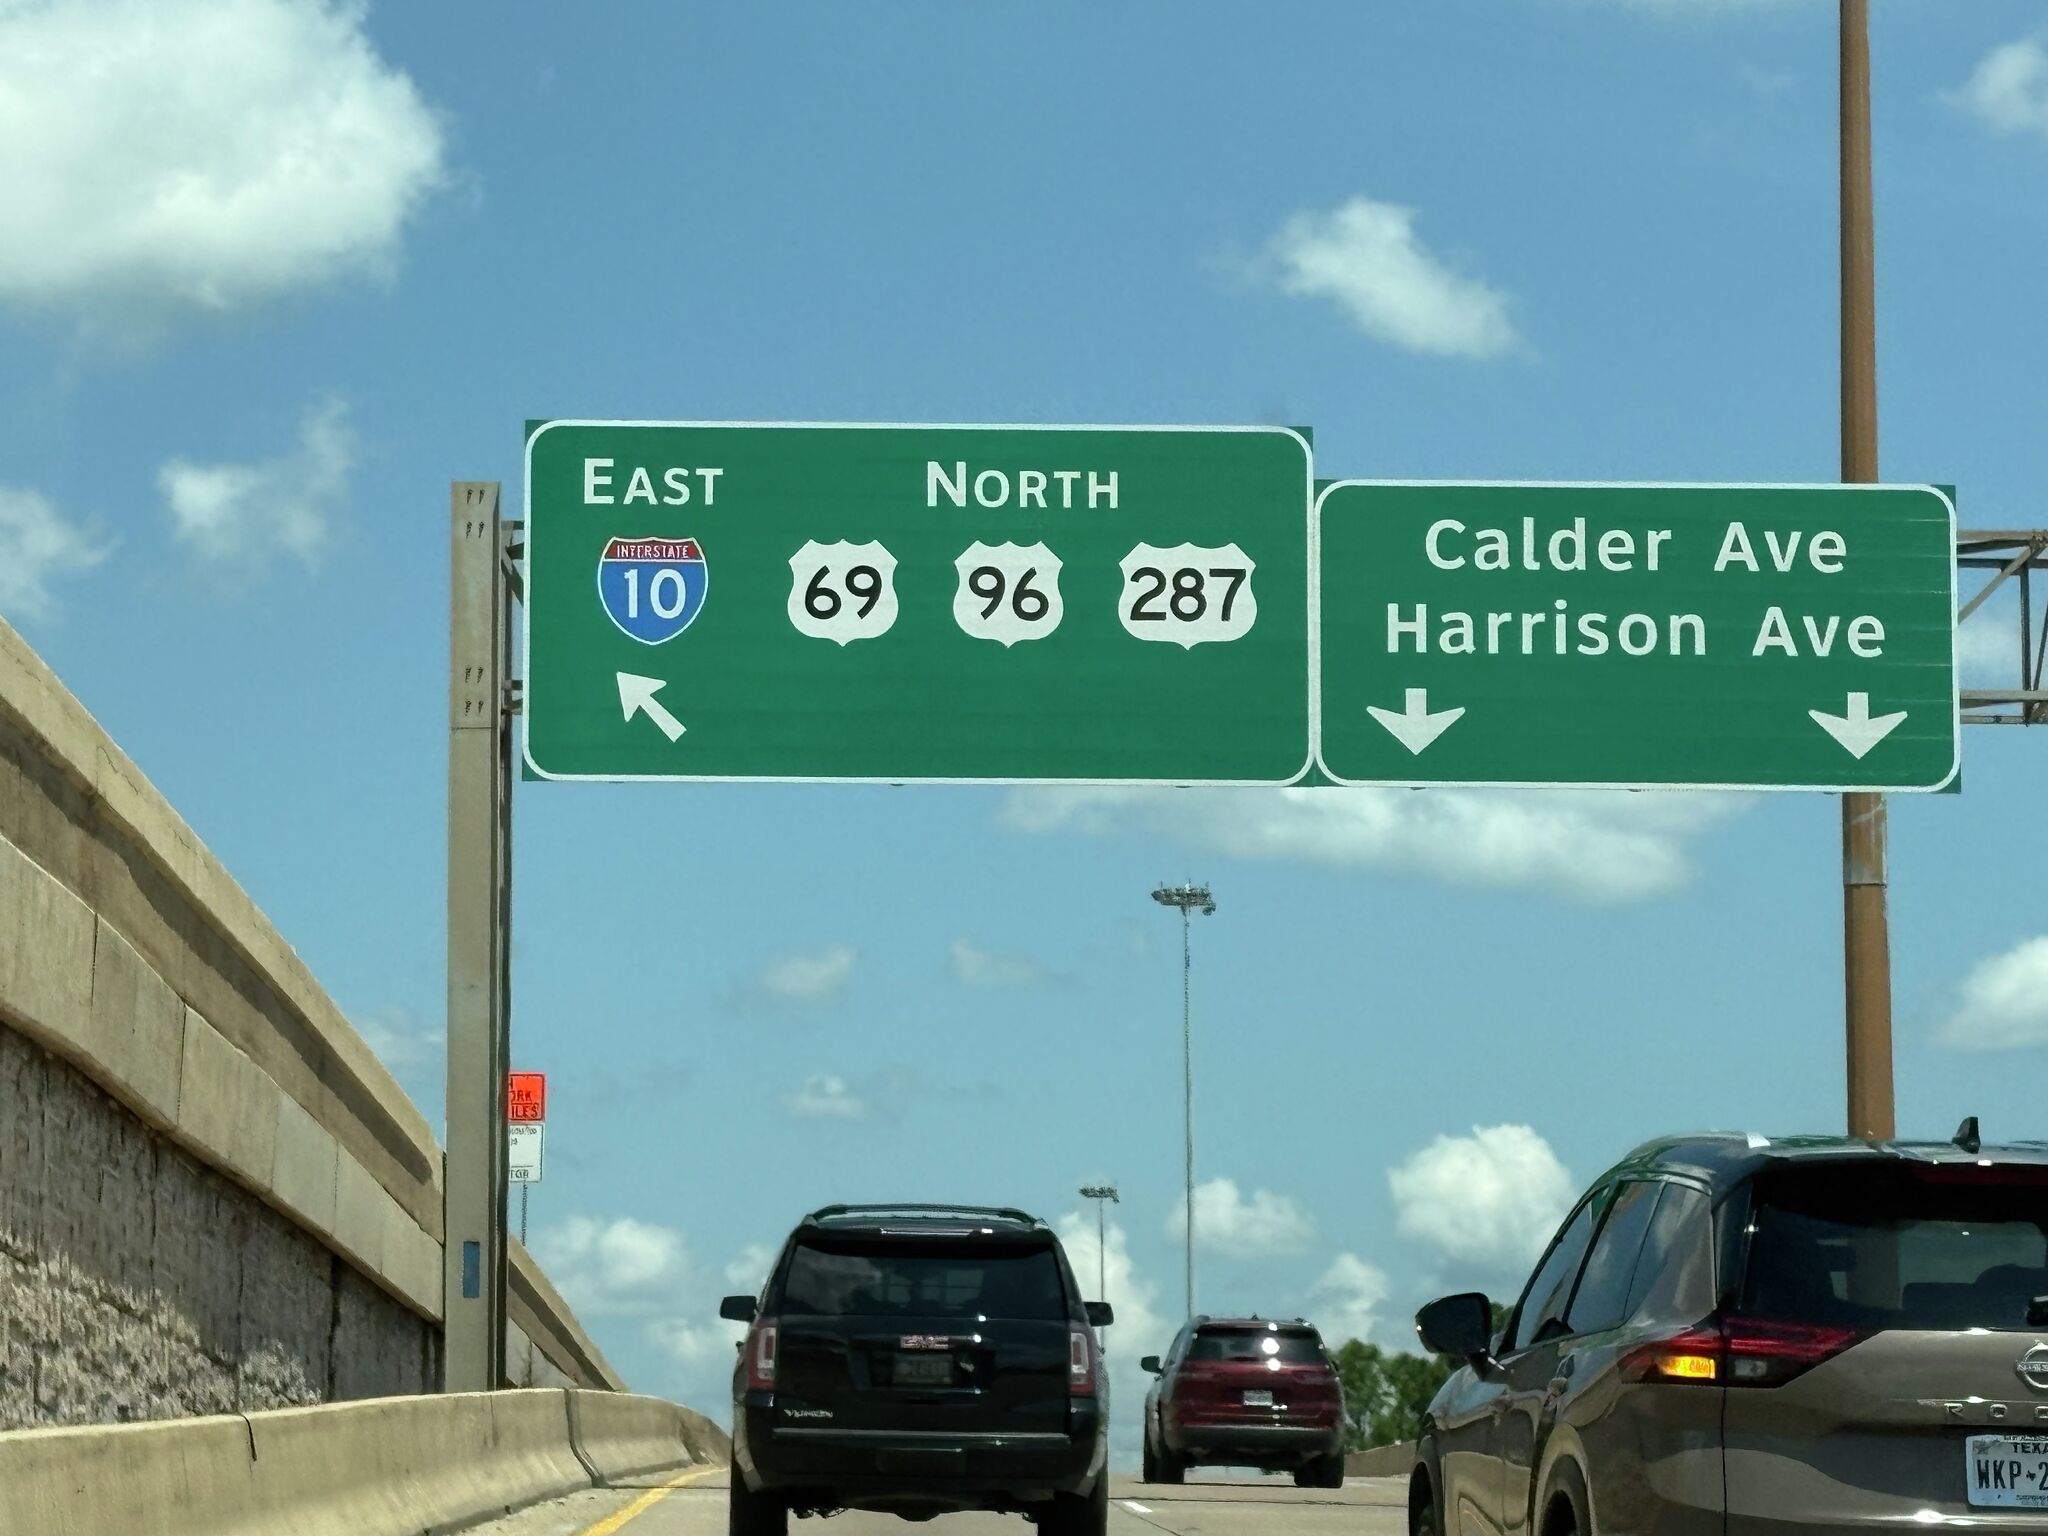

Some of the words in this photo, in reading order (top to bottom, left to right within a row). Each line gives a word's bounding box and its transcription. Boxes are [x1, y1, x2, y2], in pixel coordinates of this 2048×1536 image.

[583, 458, 724, 506] EAST
[927, 460, 1119, 509] NORTH
[616, 544, 690, 559] INTERSTATE
[1425, 516, 1672, 572] Calder
[1713, 521, 1847, 574] Ave
[624, 568, 686, 619] 10
[804, 564, 883, 620] 69
[968, 565, 1050, 622] 96
[1129, 566, 1247, 623] 287
[1387, 599, 1706, 656] Harrison
[1752, 606, 1885, 658] Ave
[510, 1090, 532, 1102] ORK
[511, 1104, 538, 1118] ILES
[2012, 1442, 2048, 1454] TEXA
